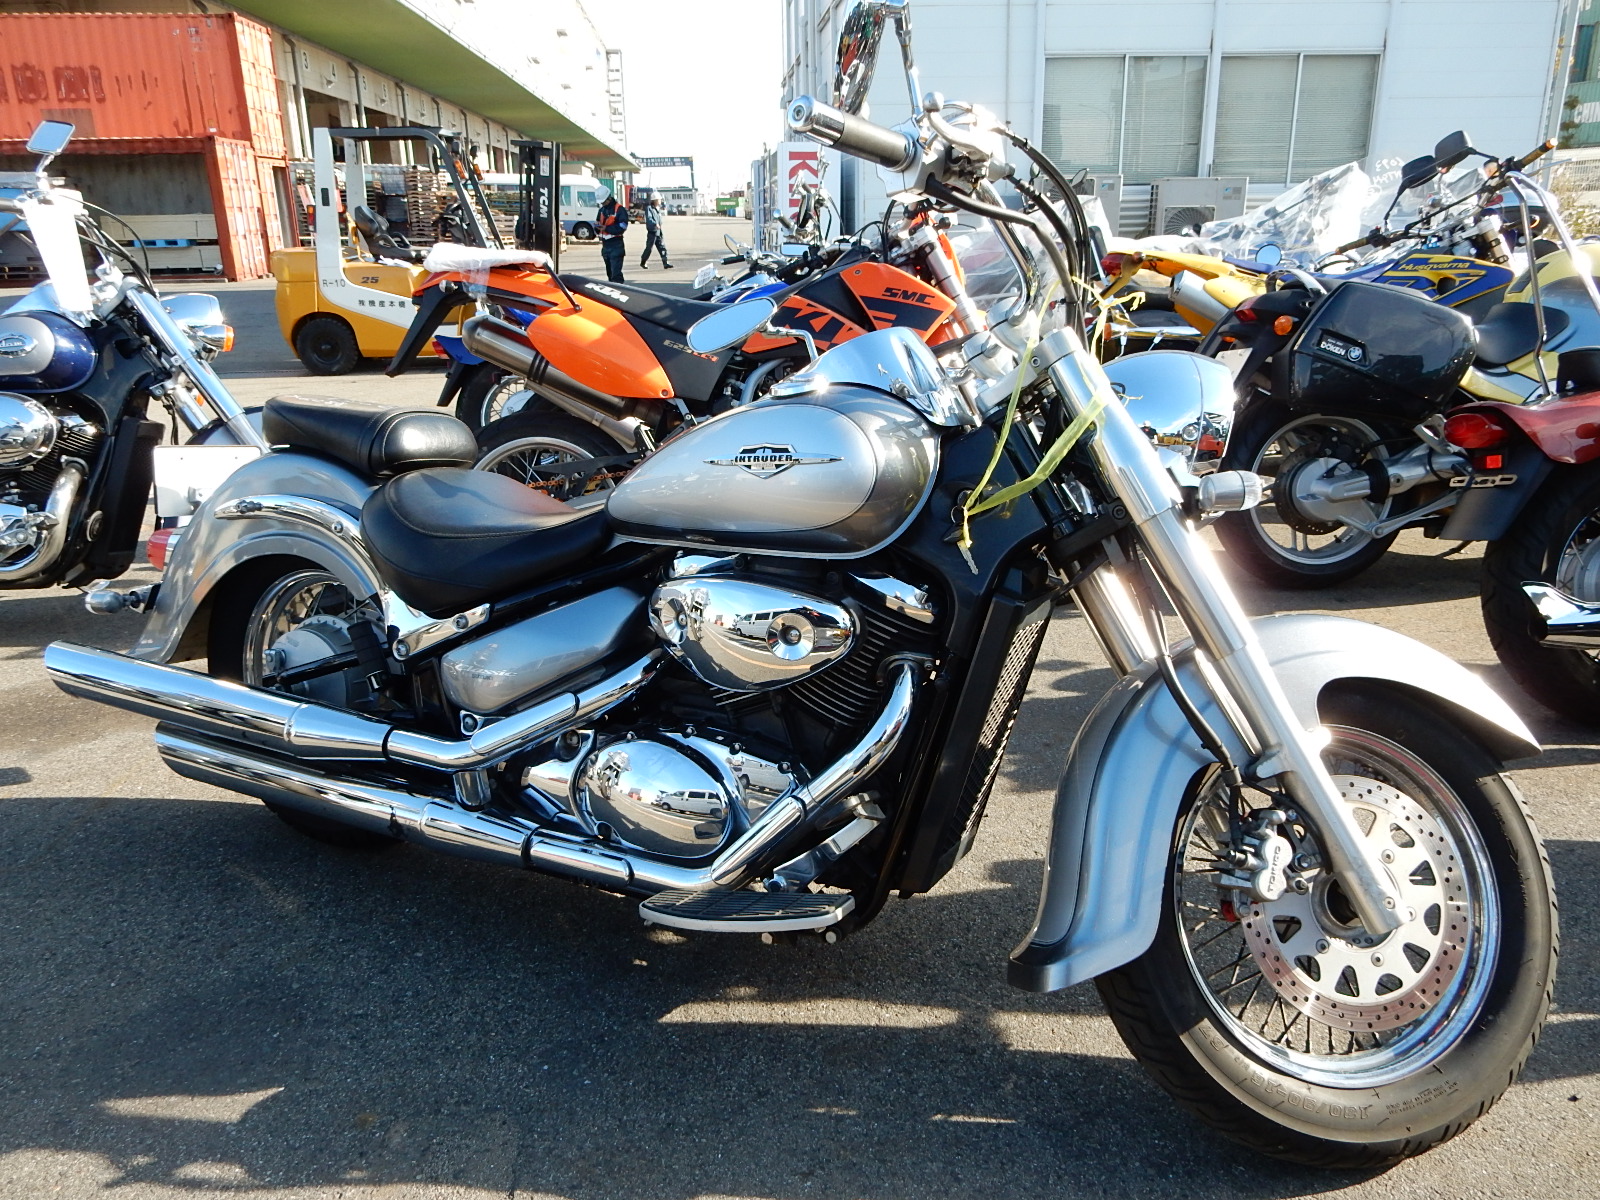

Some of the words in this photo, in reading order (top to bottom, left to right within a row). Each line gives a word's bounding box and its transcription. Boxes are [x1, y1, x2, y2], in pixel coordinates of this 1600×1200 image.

[302, 52, 309, 70] 3
[540, 187, 549, 218] TCM
[1398, 262, 1471, 271] Husqvarna
[322, 279, 346, 288] R-10
[361, 276, 379, 284] 25
[585, 282, 629, 303] KTM
[881, 287, 935, 305] SMC
[734, 454, 794, 463] INTRUDER
[1267, 845, 1281, 893] TOKICO
